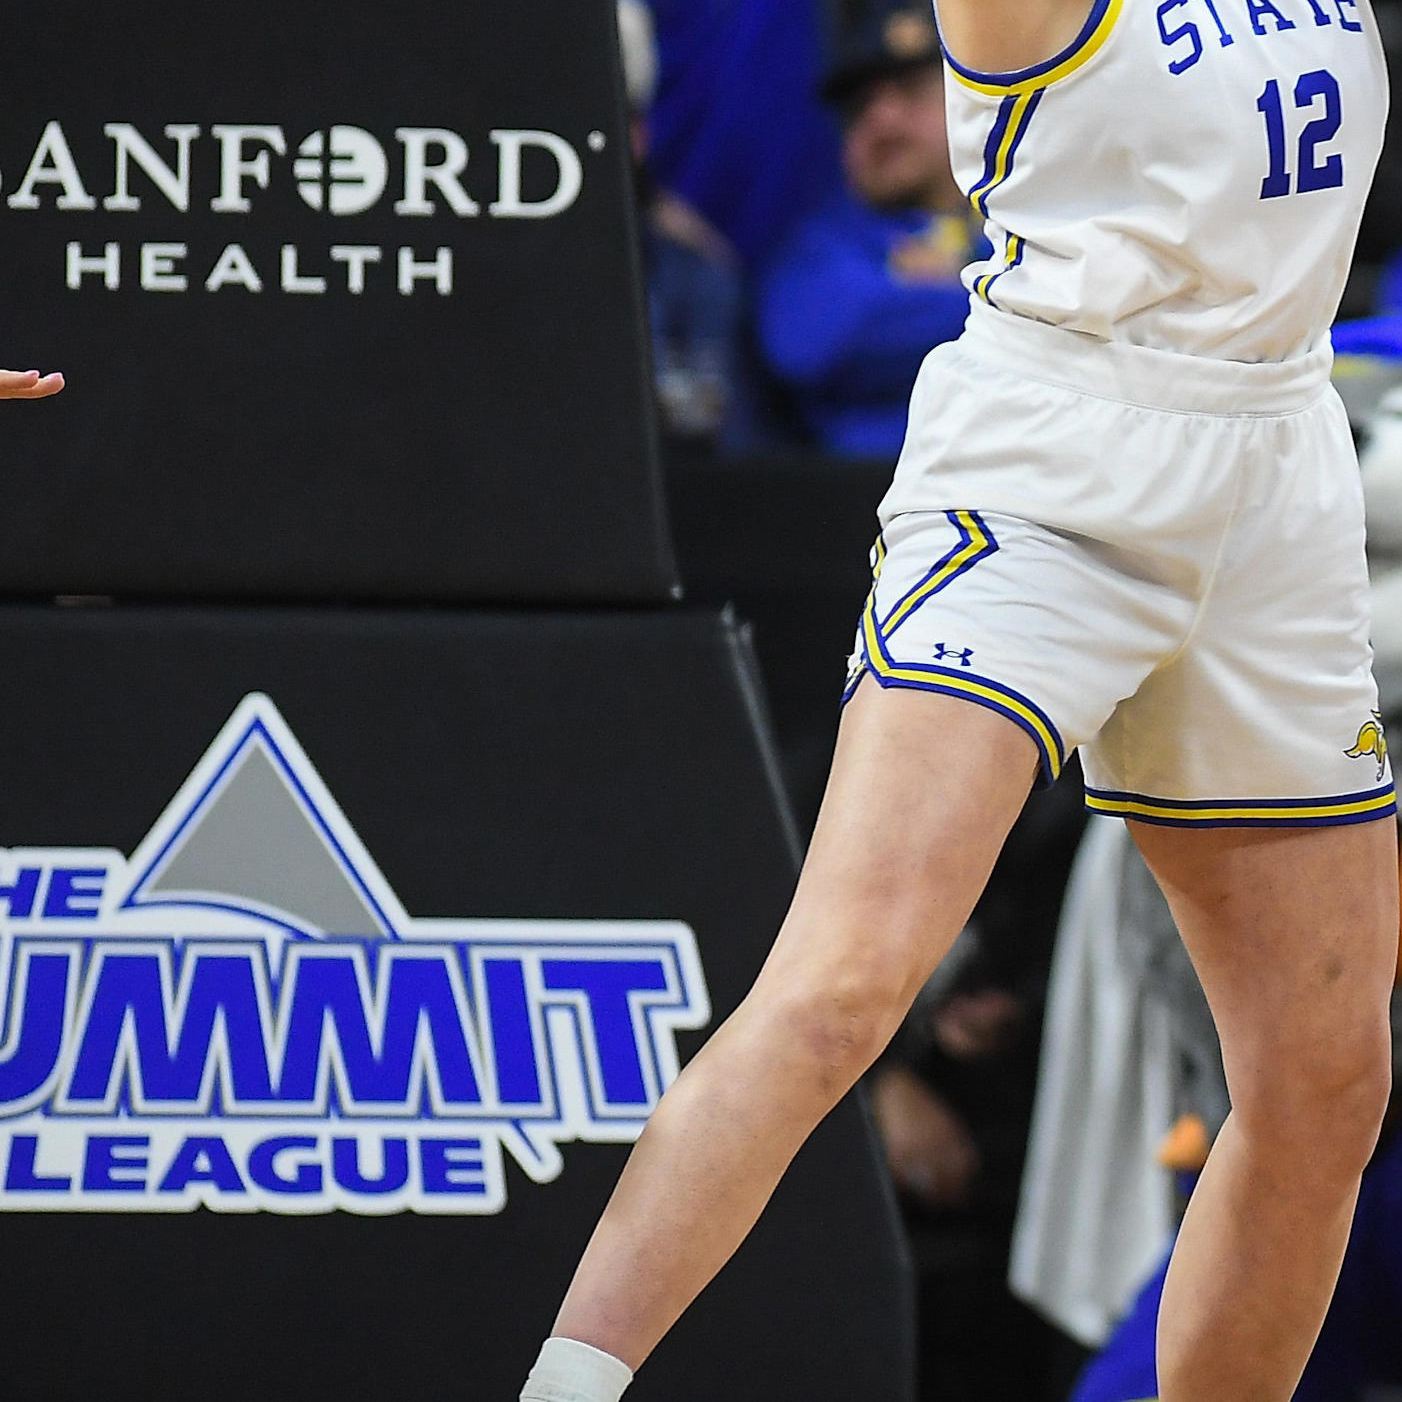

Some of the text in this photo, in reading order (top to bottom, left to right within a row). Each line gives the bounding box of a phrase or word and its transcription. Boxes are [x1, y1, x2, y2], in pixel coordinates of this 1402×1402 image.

[0, 120, 584, 219] ANFORD
[1256, 68, 1344, 200] 12
[65, 241, 454, 296] HEALTH
[3, 1134, 488, 1195] LEAGUE
